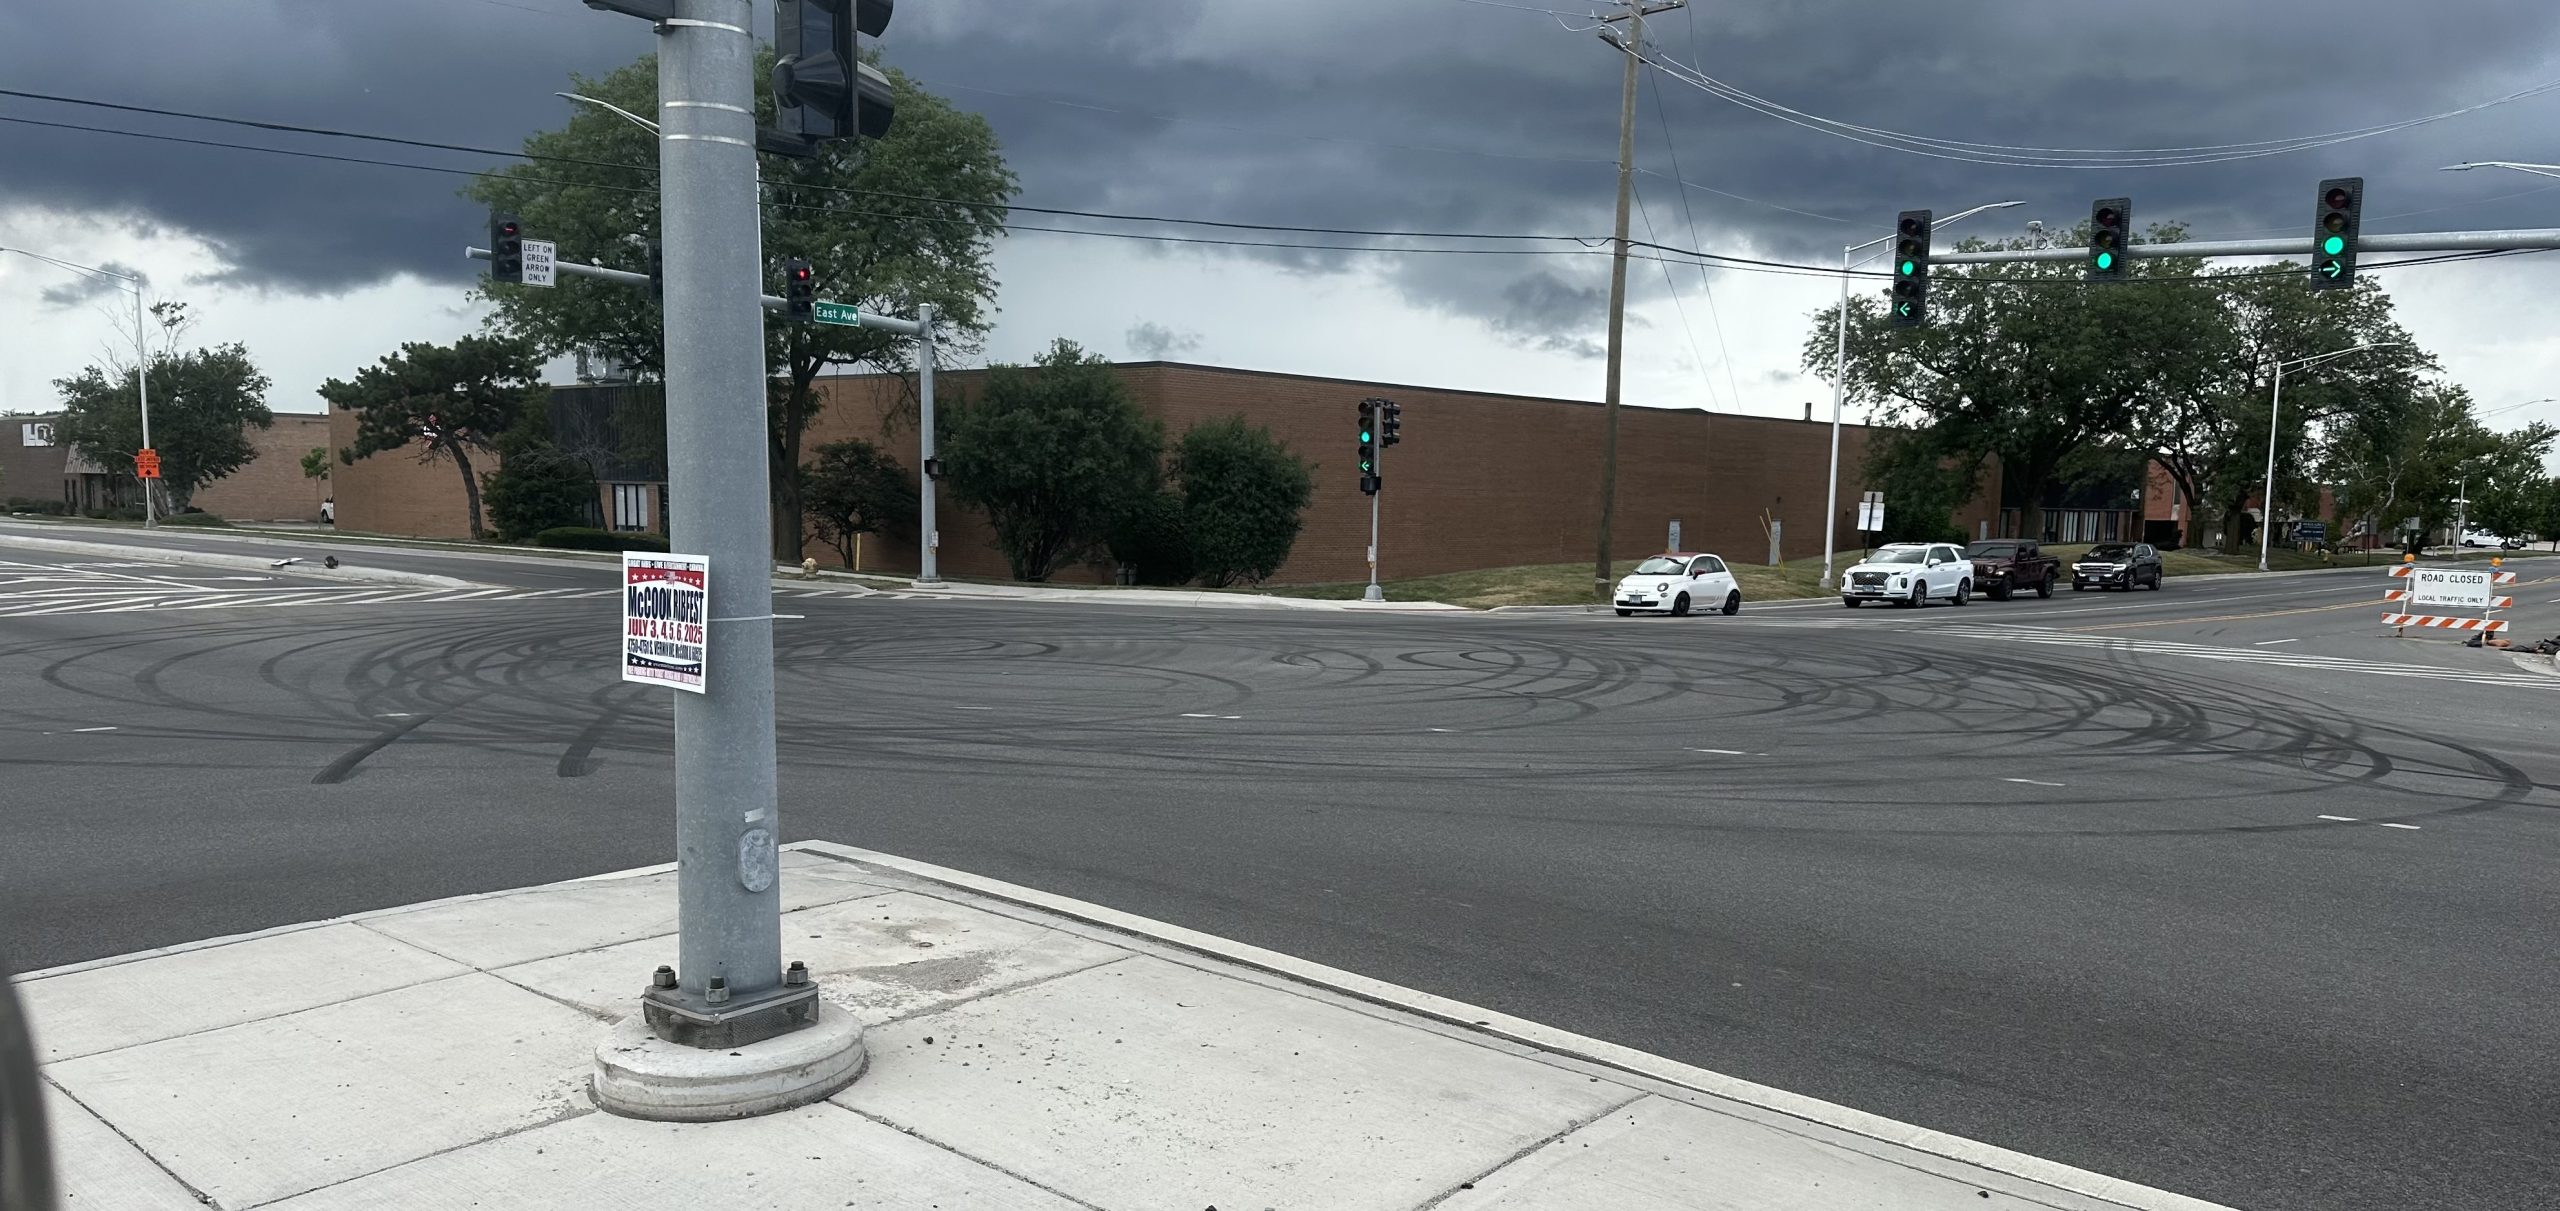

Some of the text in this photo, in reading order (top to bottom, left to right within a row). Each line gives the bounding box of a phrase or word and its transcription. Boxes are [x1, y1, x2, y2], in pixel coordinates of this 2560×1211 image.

[523, 243, 552, 254] LEFT ON
[527, 253, 549, 263] GREEN
[526, 263, 550, 272] ARROW
[528, 273, 546, 282] ONLY
[816, 307, 857, 321] East Ave
[2421, 573, 2484, 584] ROAD CLOSED
[2418, 594, 2436, 602] LOCAL
[2440, 595, 2464, 603] TRAFFIC
[628, 585, 704, 625] McCOOK RIBFEST
[628, 618, 648, 637] JULY
[650, 620, 659, 640] 3,
[661, 621, 668, 641] 4,
[684, 623, 703, 644] 2025
